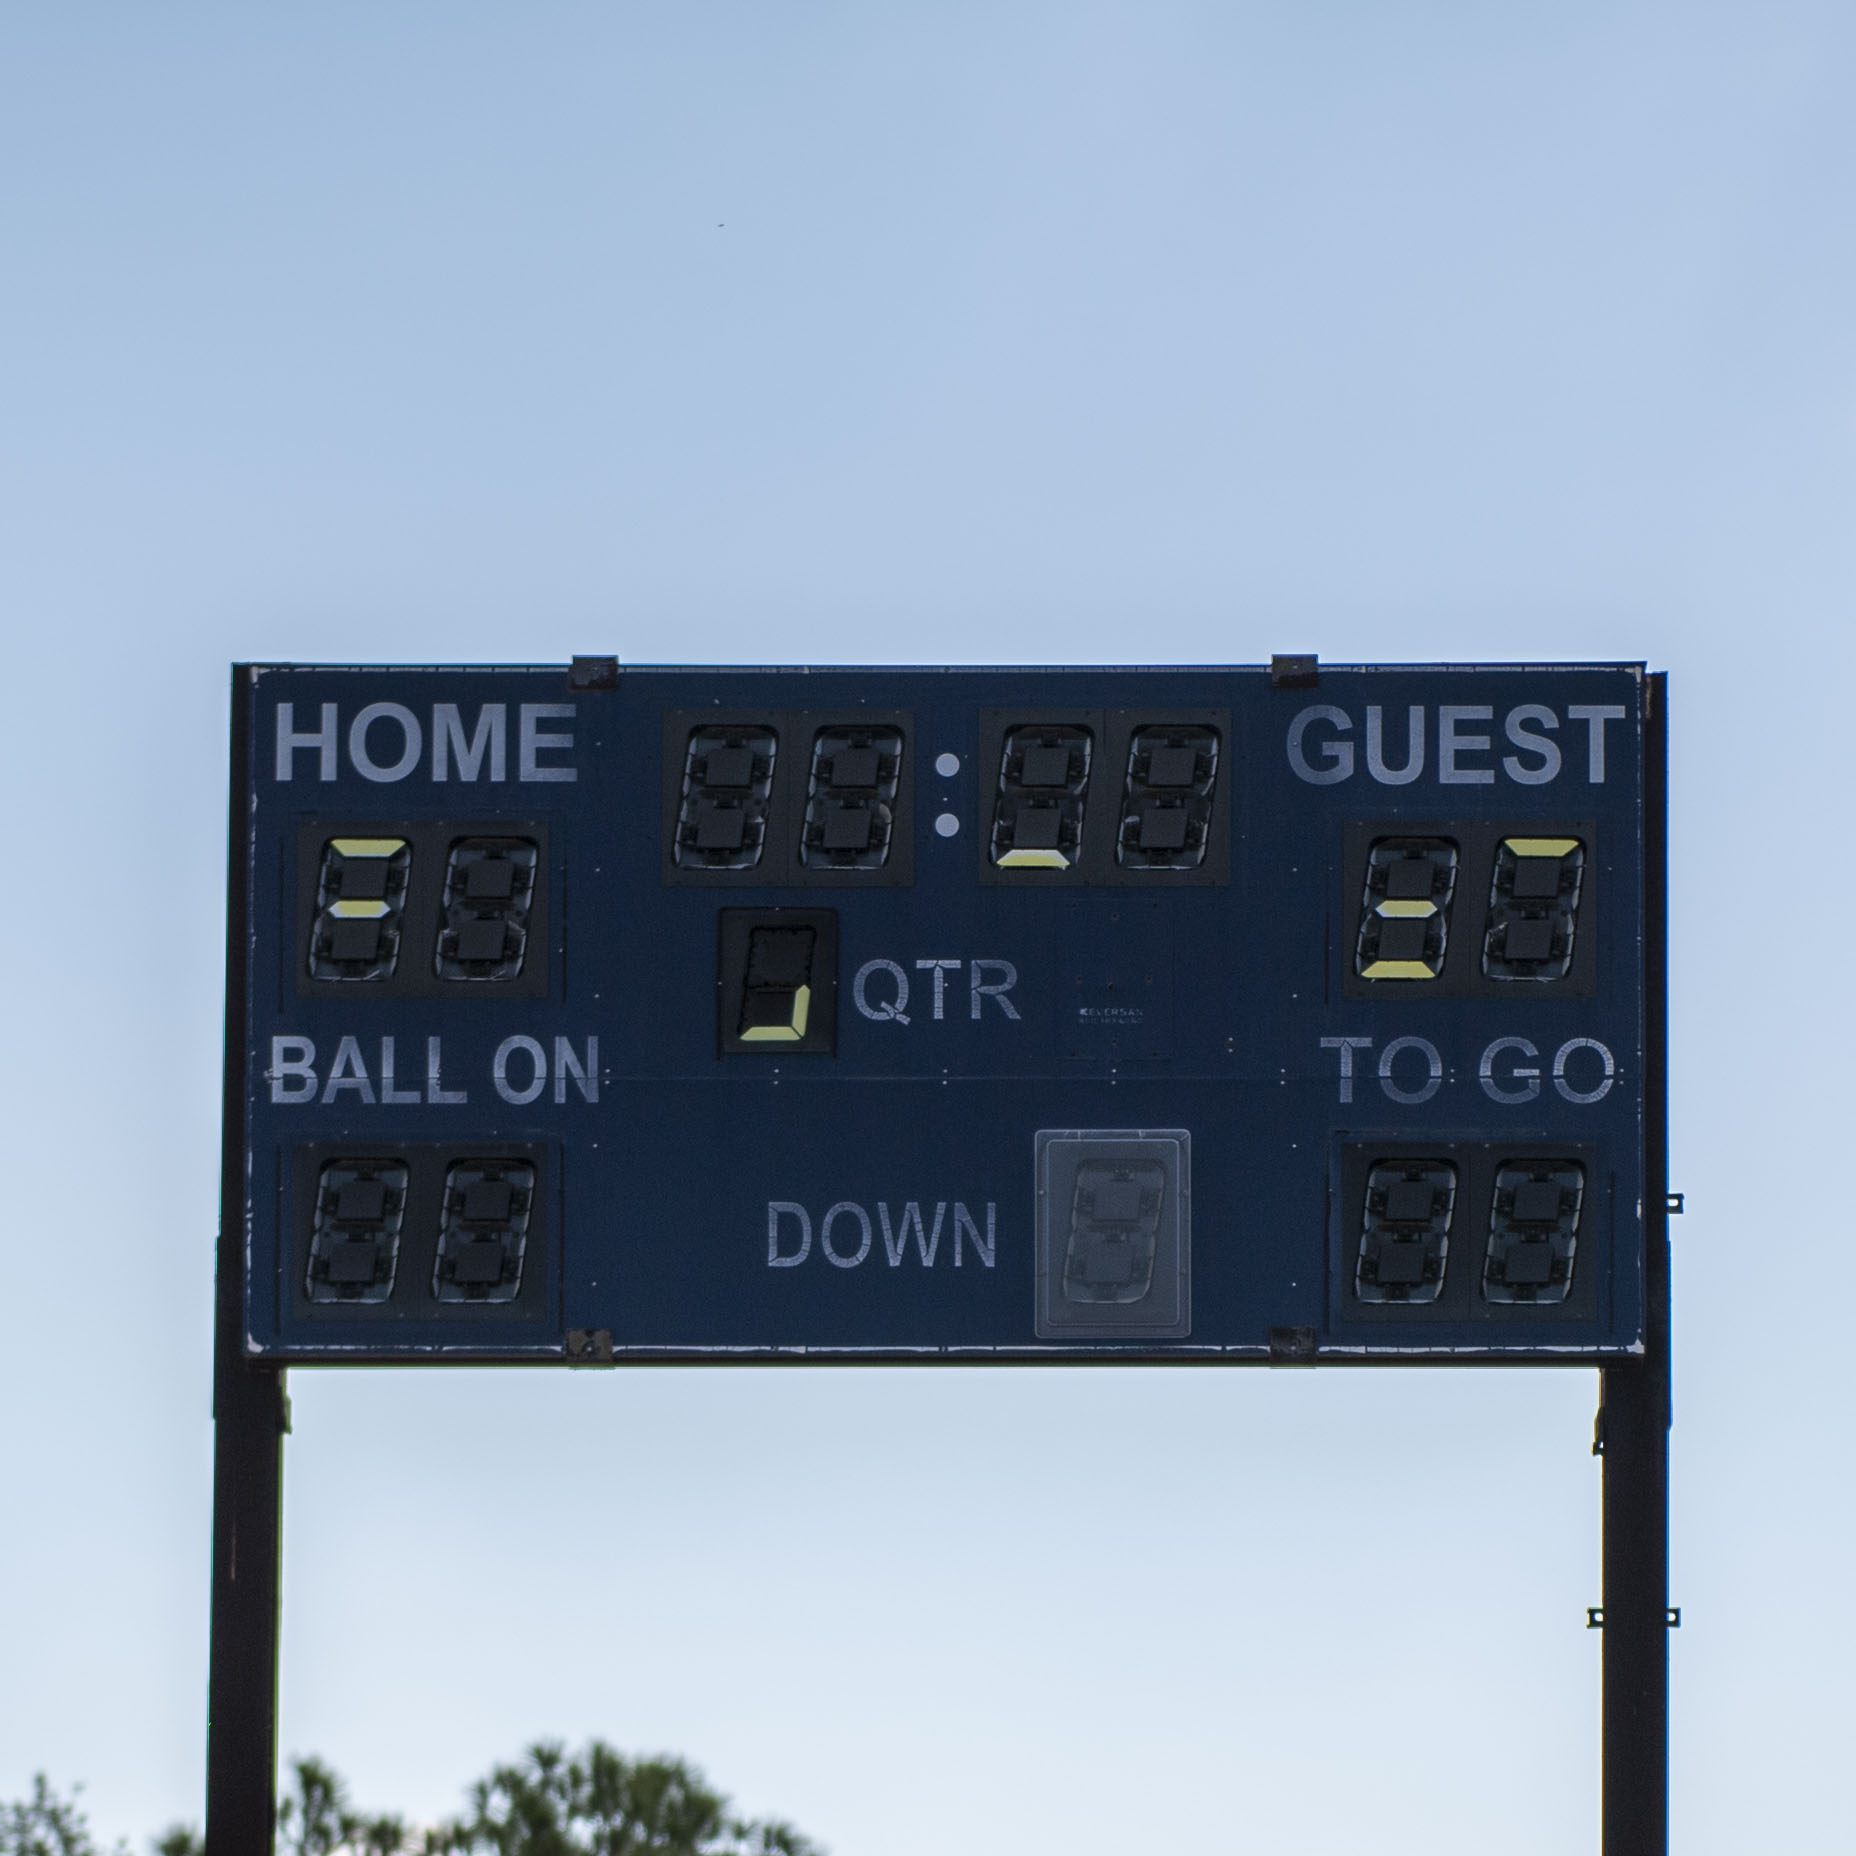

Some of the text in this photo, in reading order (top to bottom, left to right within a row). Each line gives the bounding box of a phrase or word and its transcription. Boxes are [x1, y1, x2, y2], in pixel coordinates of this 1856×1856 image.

[274, 702, 577, 782] HOME
[1286, 704, 1626, 785] GUEST
[853, 959, 1021, 1025] QTR
[271, 1035, 599, 1104] BALL ON
[1320, 1036, 1615, 1103] TO GO
[767, 1201, 996, 1268] DOWN
